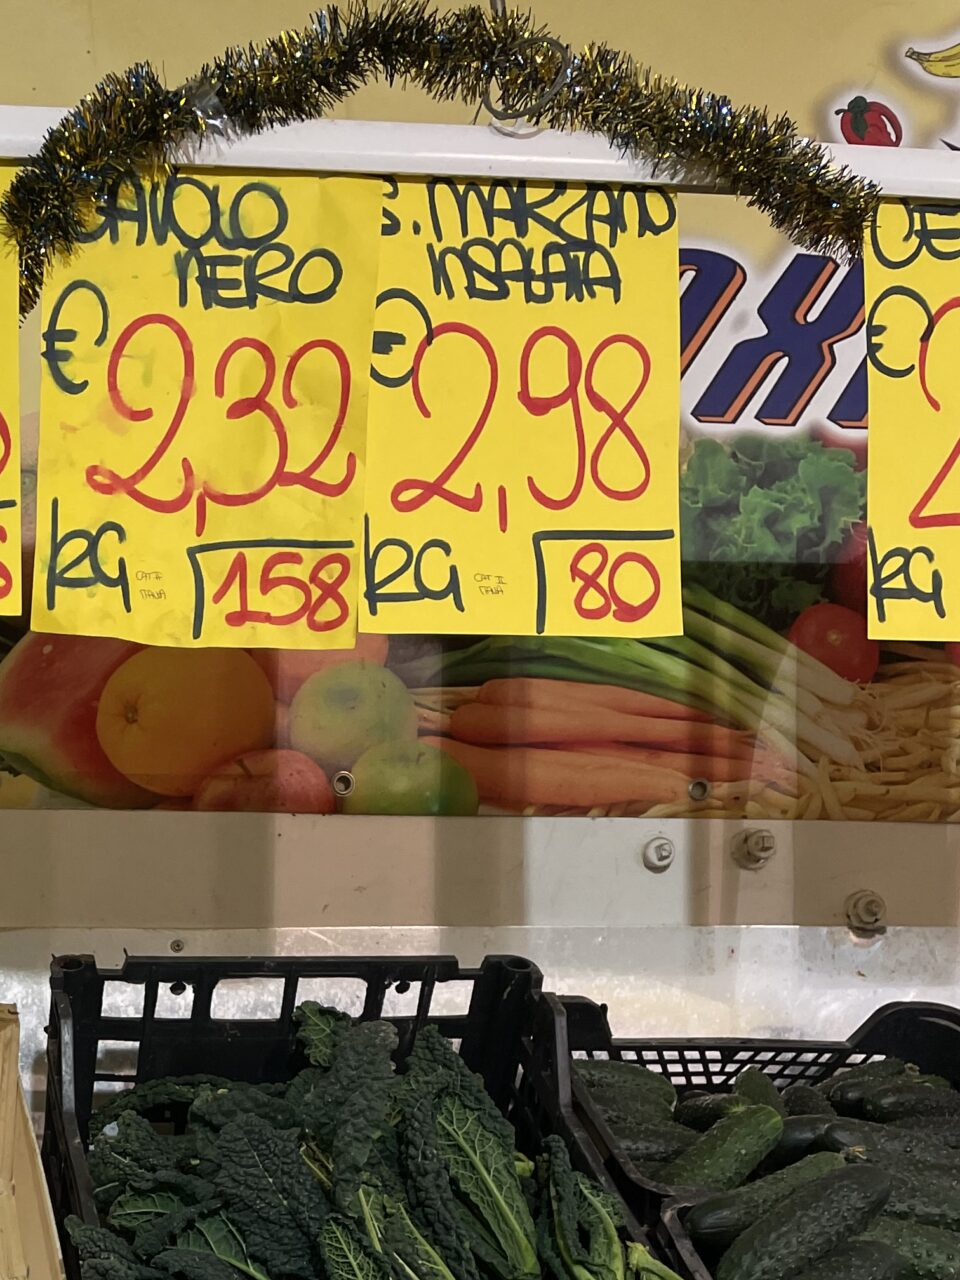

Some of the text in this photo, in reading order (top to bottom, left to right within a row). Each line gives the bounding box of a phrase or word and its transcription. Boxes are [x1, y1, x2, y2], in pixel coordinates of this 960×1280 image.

[85, 313, 357, 538] 2,32
[390, 321, 652, 534] 2,98
[212, 550, 352, 632] 158
[570, 542, 661, 623] 80
